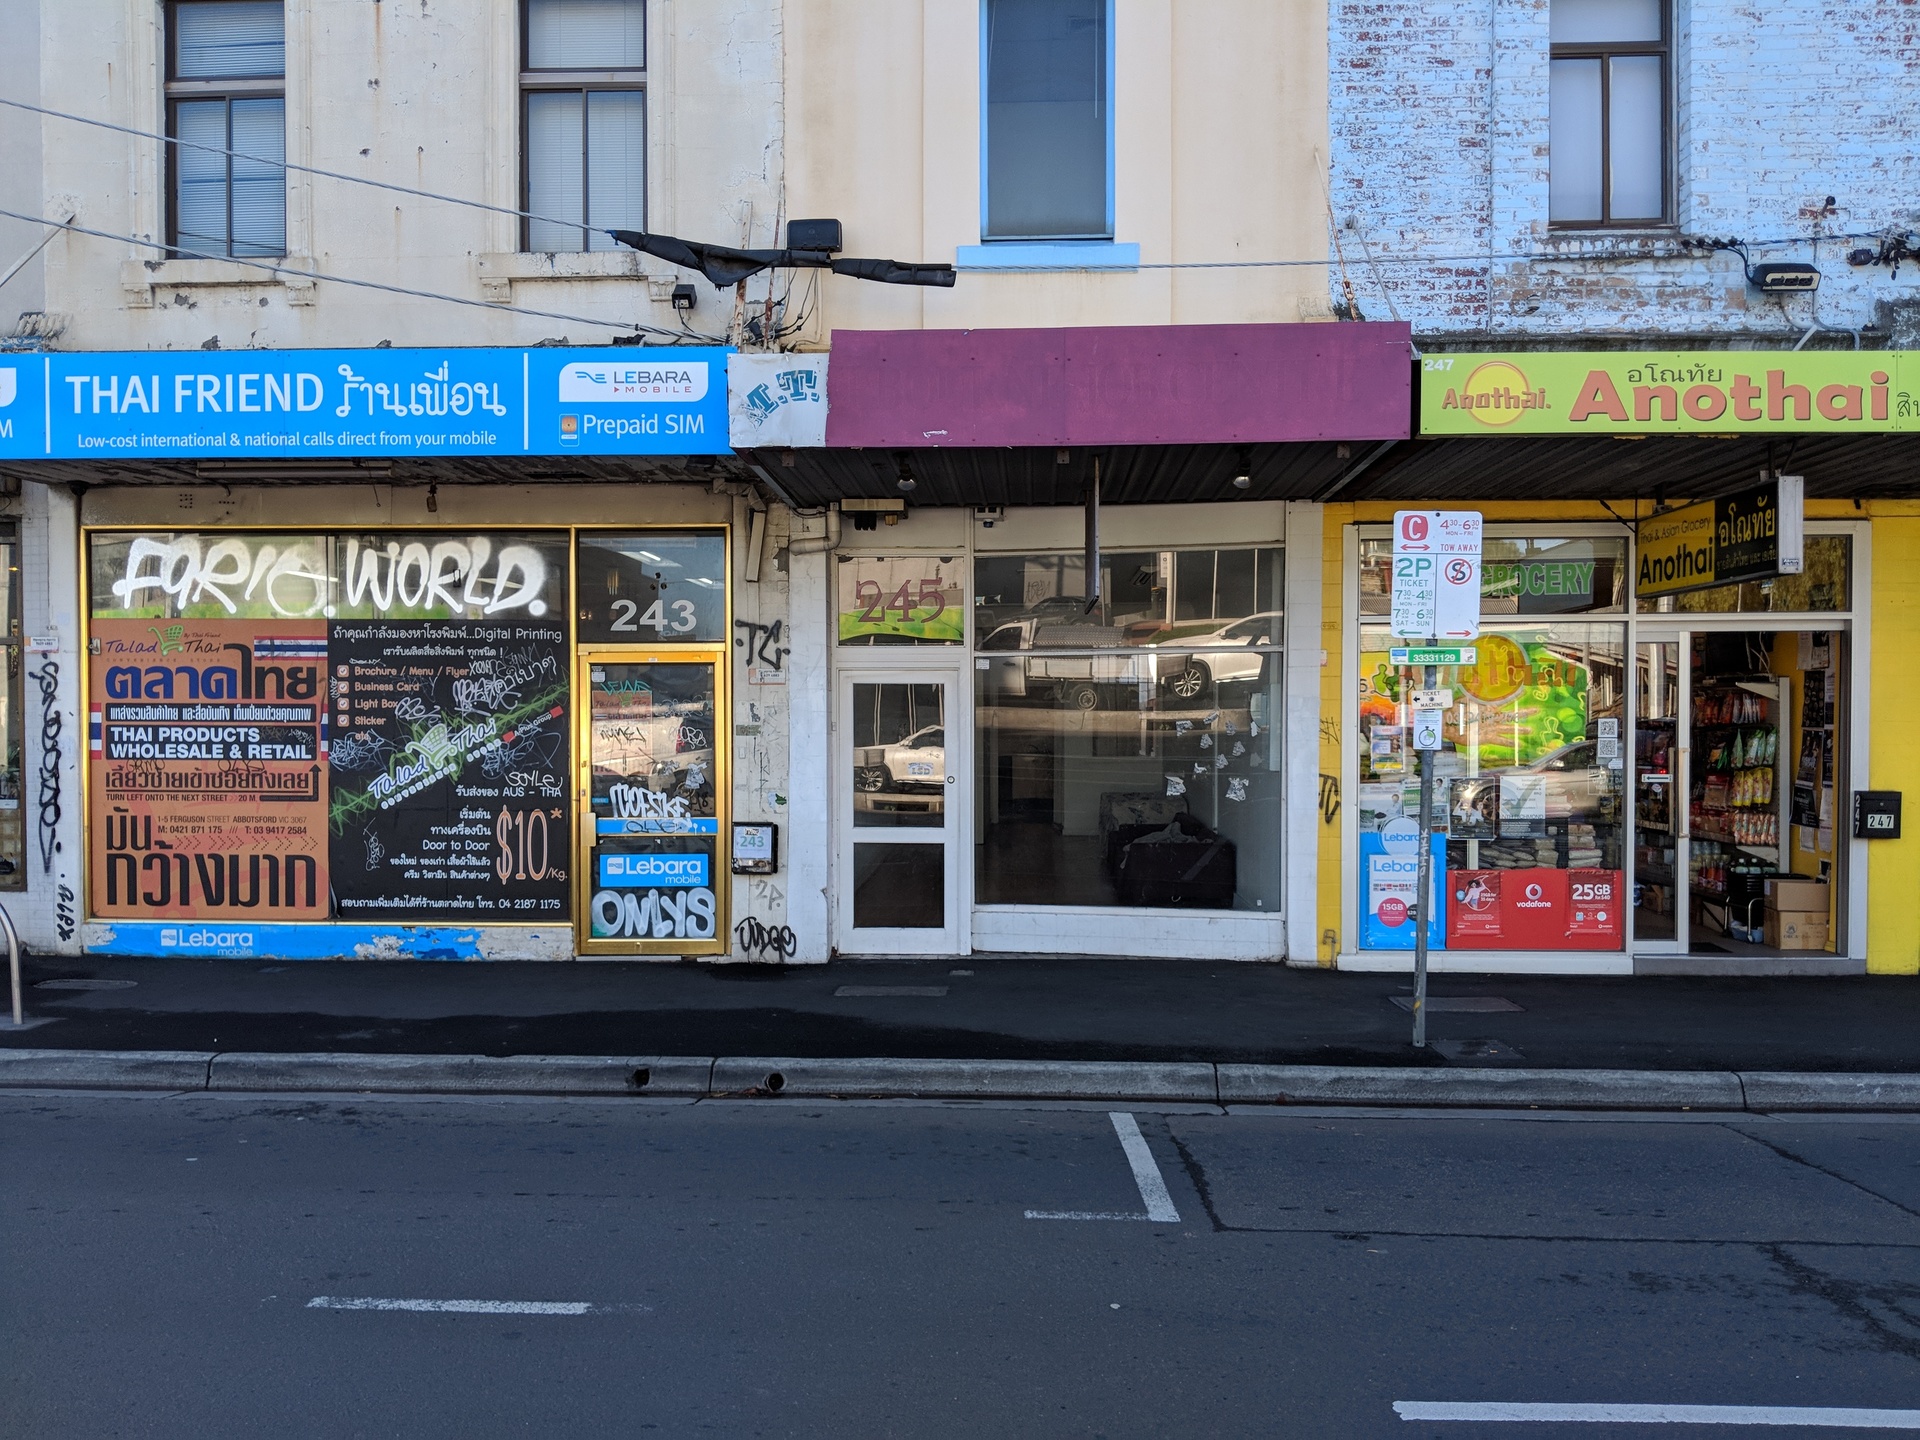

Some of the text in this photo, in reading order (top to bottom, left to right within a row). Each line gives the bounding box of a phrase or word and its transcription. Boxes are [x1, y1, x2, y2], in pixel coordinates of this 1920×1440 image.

[1424, 359, 1454, 371] 247
[613, 371, 692, 384] LEBARA
[1626, 363, 1723, 383] อโณทัย
[65, 373, 324, 414] THAI FRIEND
[336, 360, 507, 418] ร้านเพื่อน
[1568, 369, 1890, 423] Anothai
[583, 414, 705, 439] Prepaid SIM
[78, 430, 497, 449] Low-cost international & national calls direct from your mobile
[1661, 524, 1681, 539] Asian
[1681, 517, 1711, 533] Grocery
[1397, 557, 1432, 577] 2P
[1638, 537, 1714, 586] Anothai
[1400, 579, 1428, 587] TICKET
[1481, 562, 1596, 596] GROCERY
[856, 577, 945, 623] 245
[610, 600, 697, 631] 243
[516, 628, 562, 642] Printing
[106, 639, 222, 653] Talad Thai
[1413, 654, 1456, 662] 33331129
[105, 644, 317, 699] ตลาดไทย
[354, 666, 398, 676] Brochure
[409, 667, 434, 676] Menu
[446, 667, 469, 678] Flyer
[354, 682, 420, 691] Business Card
[354, 698, 399, 710] Light Box
[354, 716, 387, 725] Sticker
[111, 727, 260, 742] THAI PRODUCTS
[111, 744, 312, 760] WHOLESALE & RETAIL
[367, 718, 498, 799] Talad Thai
[456, 785, 498, 797] รับส่งของ
[503, 787, 525, 797] AUS
[540, 787, 562, 797] THA
[290, 816, 307, 824] 3067
[1869, 815, 1892, 828] 247
[157, 826, 168, 834] M:
[170, 826, 188, 834] 0421
[190, 826, 205, 834] 871
[208, 826, 222, 834] 175
[245, 826, 251, 834] T:
[253, 826, 263, 834] 03
[265, 826, 286, 834] 9417
[287, 826, 307, 834] 2584
[422, 840, 490, 850] Door to Door
[739, 836, 765, 848] 243
[626, 857, 701, 875] Lebara
[1374, 860, 1419, 872] Lebar
[665, 875, 701, 884] mobile
[499, 899, 511, 909] 04
[514, 899, 536, 909] 2187
[540, 899, 561, 909] 1175
[1516, 900, 1551, 908] vodafone
[179, 929, 253, 947] Lebara
[217, 947, 253, 956] mobile
